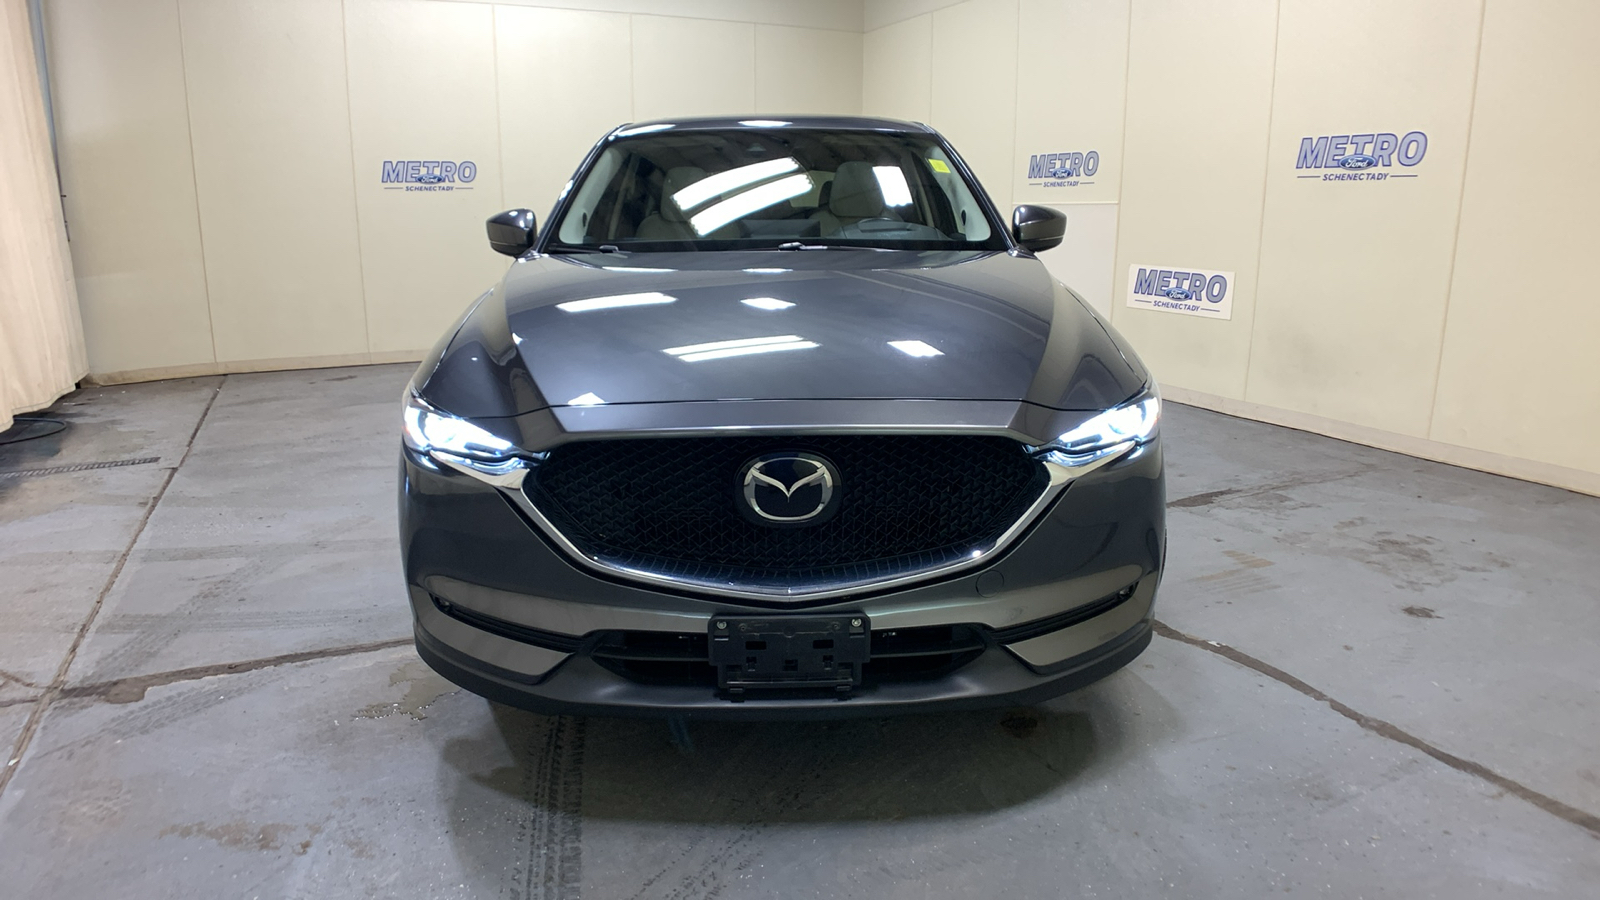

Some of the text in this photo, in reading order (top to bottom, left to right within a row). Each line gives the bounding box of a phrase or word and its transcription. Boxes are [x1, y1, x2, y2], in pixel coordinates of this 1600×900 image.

[1295, 131, 1428, 169] METRO
[381, 160, 477, 183] METRO
[1027, 150, 1100, 179] METRO
[1345, 158, 1369, 168] Ford
[1322, 172, 1389, 181] SCHENECTADY
[1133, 268, 1228, 303] METRO
[1168, 289, 1186, 300] Ford
[1153, 300, 1201, 312] SCHENECTADY
